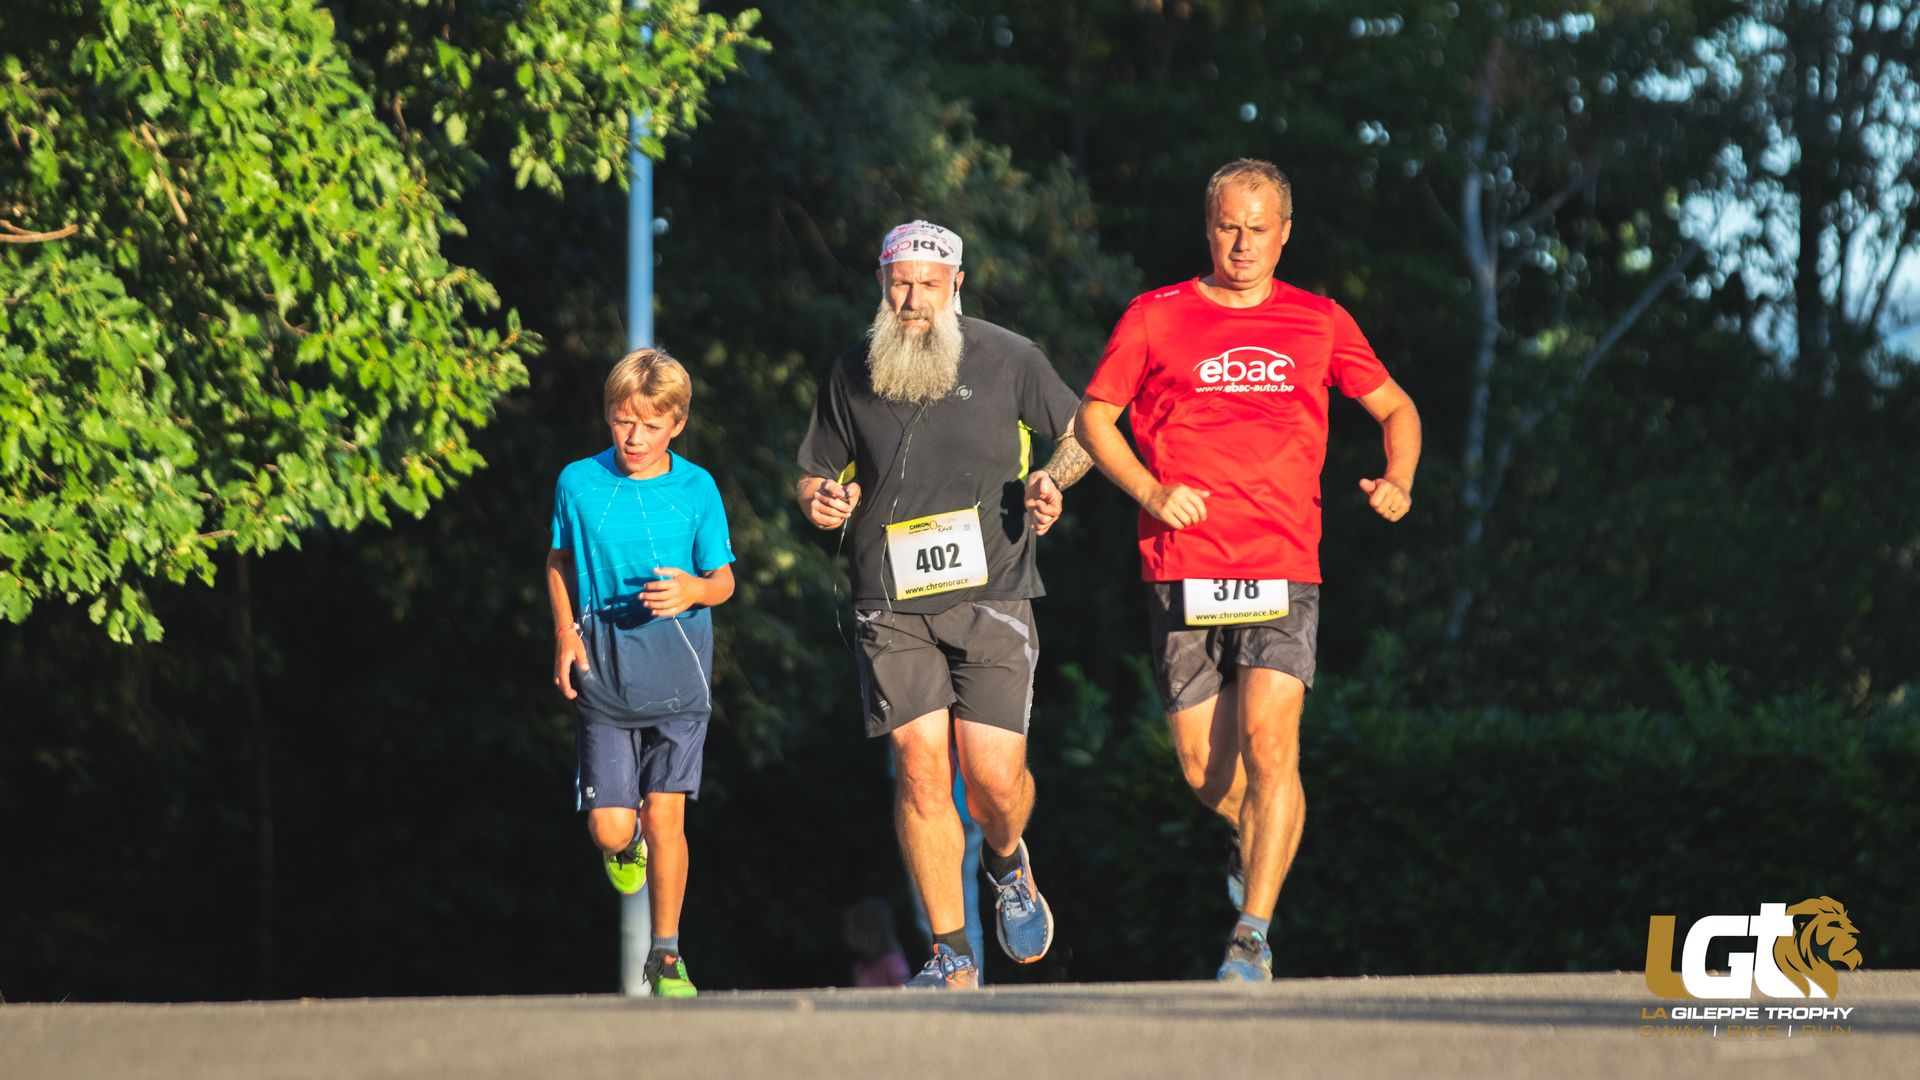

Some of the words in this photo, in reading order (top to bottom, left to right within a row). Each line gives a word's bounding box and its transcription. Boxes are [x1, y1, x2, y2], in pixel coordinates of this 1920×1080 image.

[1200, 352, 1288, 383] ebac
[1195, 382, 1295, 393] www.ebac-auto.be
[916, 543, 962, 573] 402
[1213, 579, 1260, 602] 378
[1196, 609, 1280, 620] www.chronorace.be
